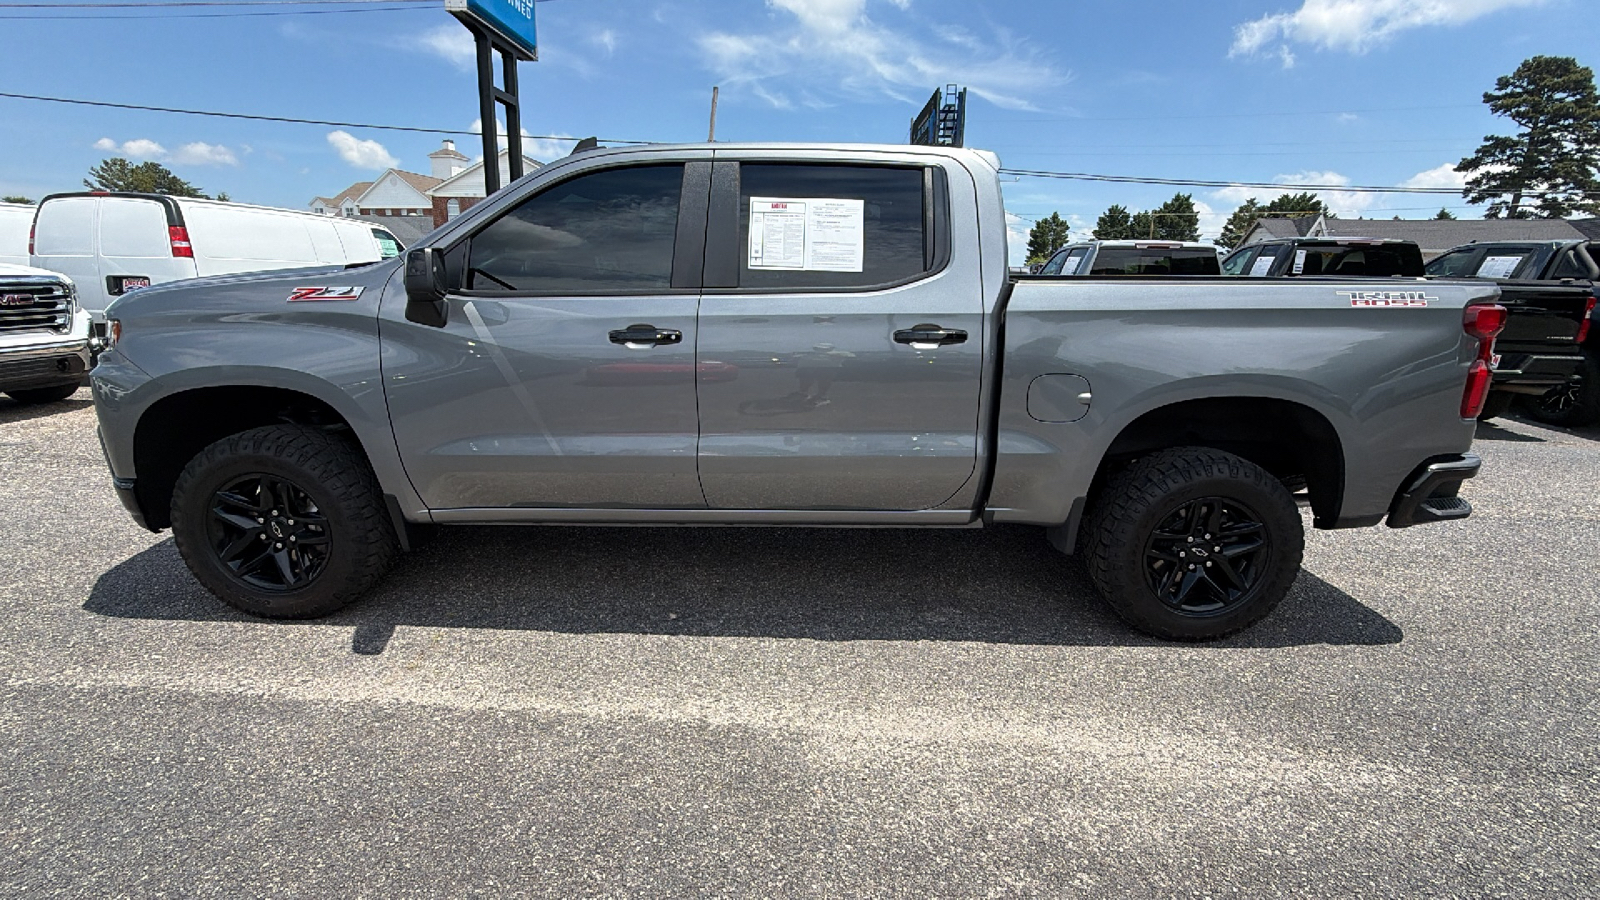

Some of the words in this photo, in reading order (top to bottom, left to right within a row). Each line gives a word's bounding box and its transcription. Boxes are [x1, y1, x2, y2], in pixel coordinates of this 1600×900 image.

[286, 286, 366, 302] Z71
[1336, 290, 1439, 301] TRAIL
[0, 294, 34, 306] MC
[1351, 299, 1428, 308] BOSS
